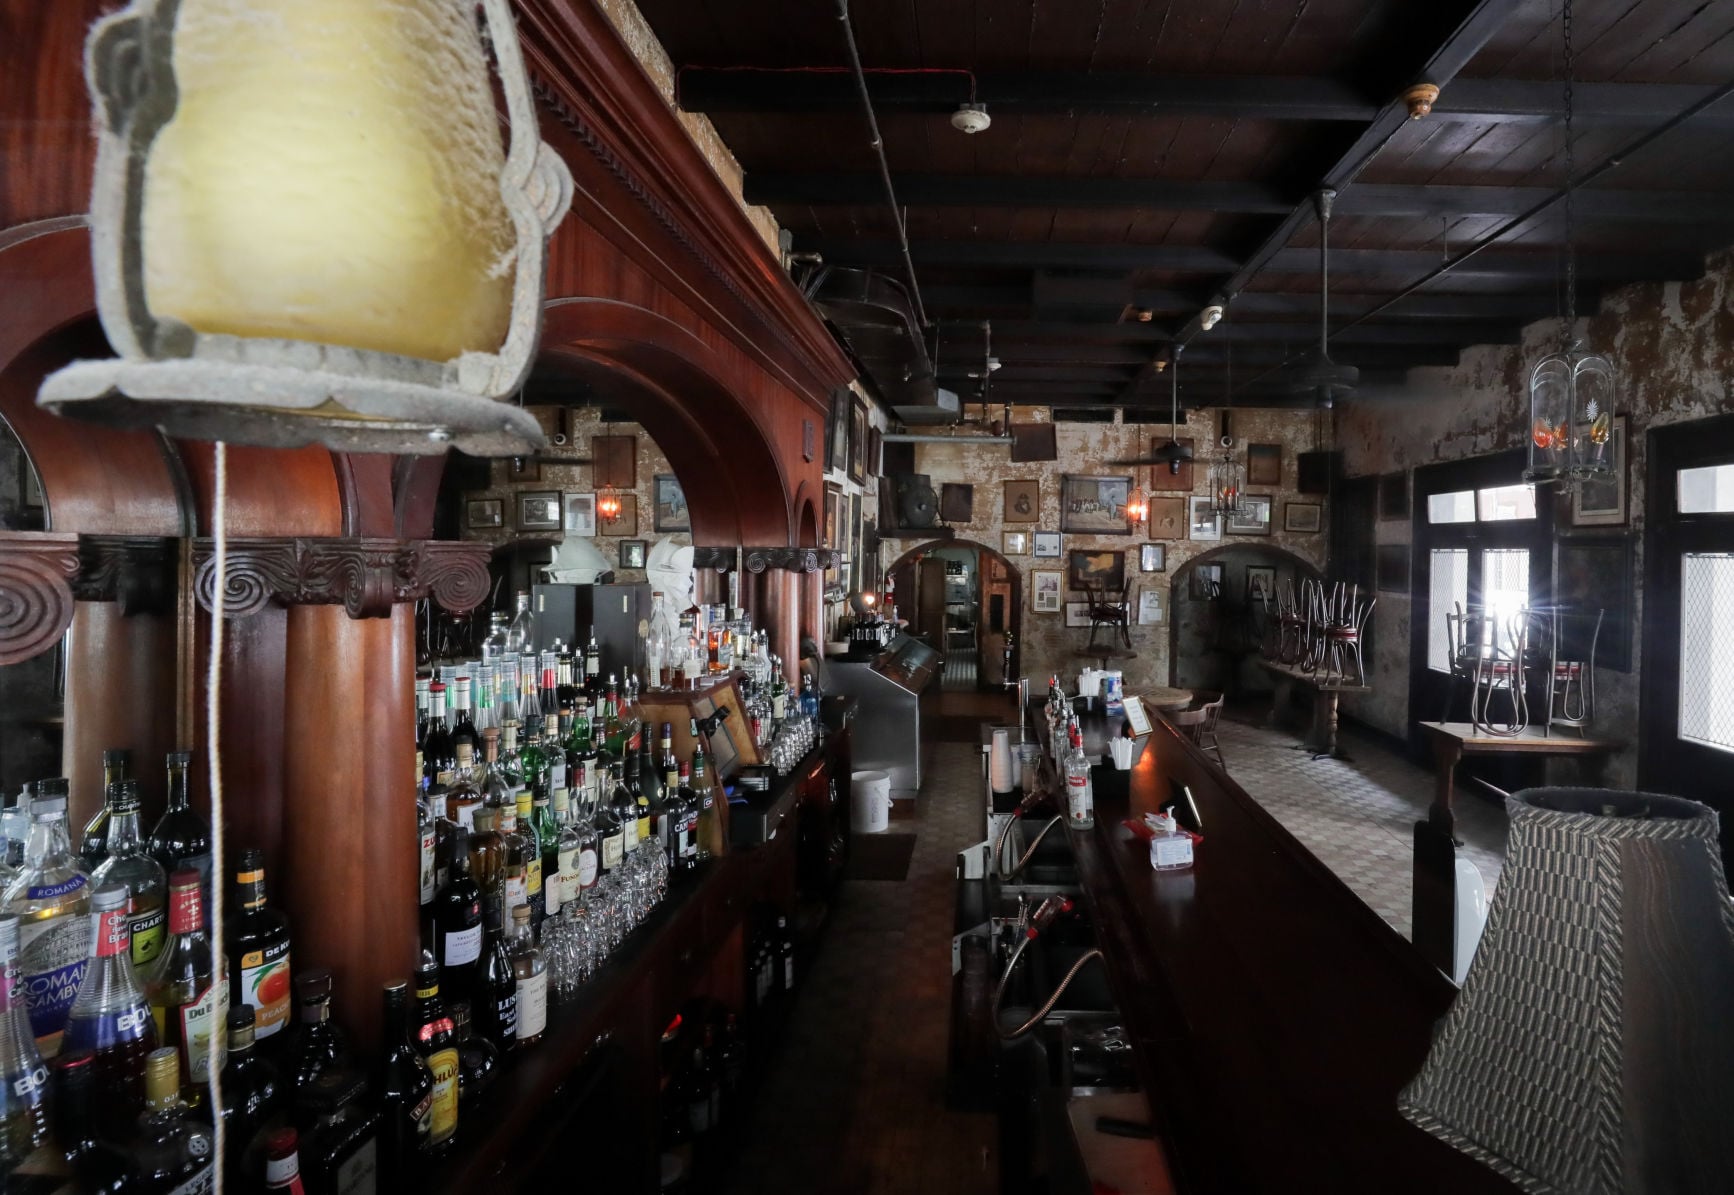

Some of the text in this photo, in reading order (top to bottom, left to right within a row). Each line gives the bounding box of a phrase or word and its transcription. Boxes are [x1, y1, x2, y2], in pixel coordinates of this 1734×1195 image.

[37, 878, 82, 898] ROMANA
[265, 947, 279, 958] DE
[188, 1006, 205, 1020] Du
